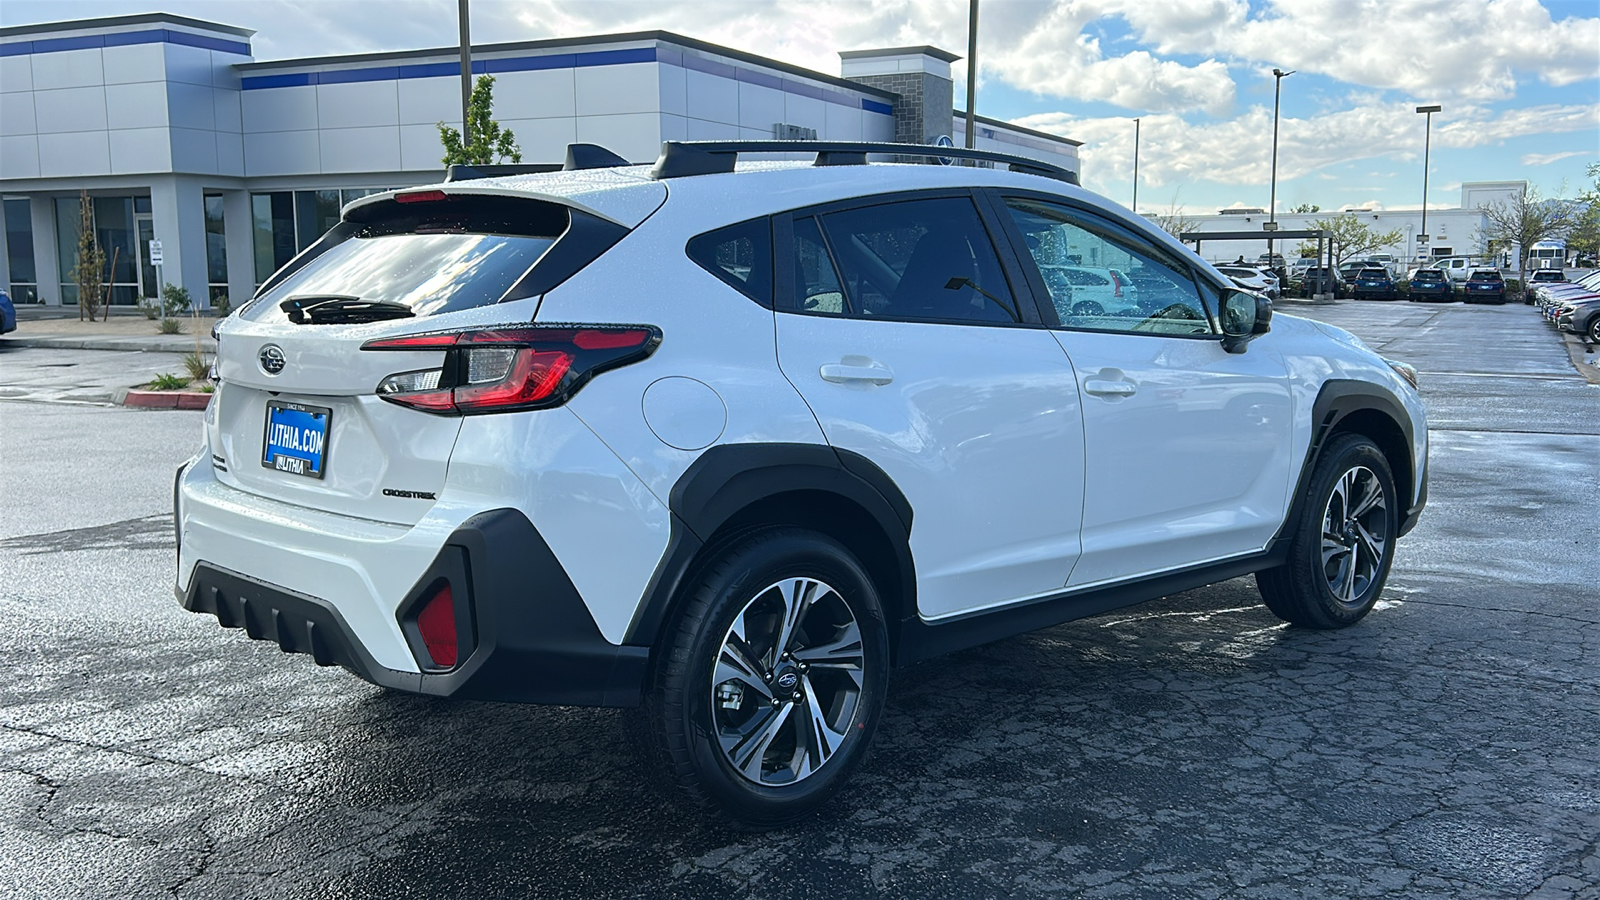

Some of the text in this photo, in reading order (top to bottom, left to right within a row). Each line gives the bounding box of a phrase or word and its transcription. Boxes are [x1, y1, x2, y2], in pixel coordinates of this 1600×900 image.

[269, 422, 324, 455] LITHIA.COM
[282, 457, 304, 474] LITHIA
[382, 488, 437, 500] CROSSTREK
